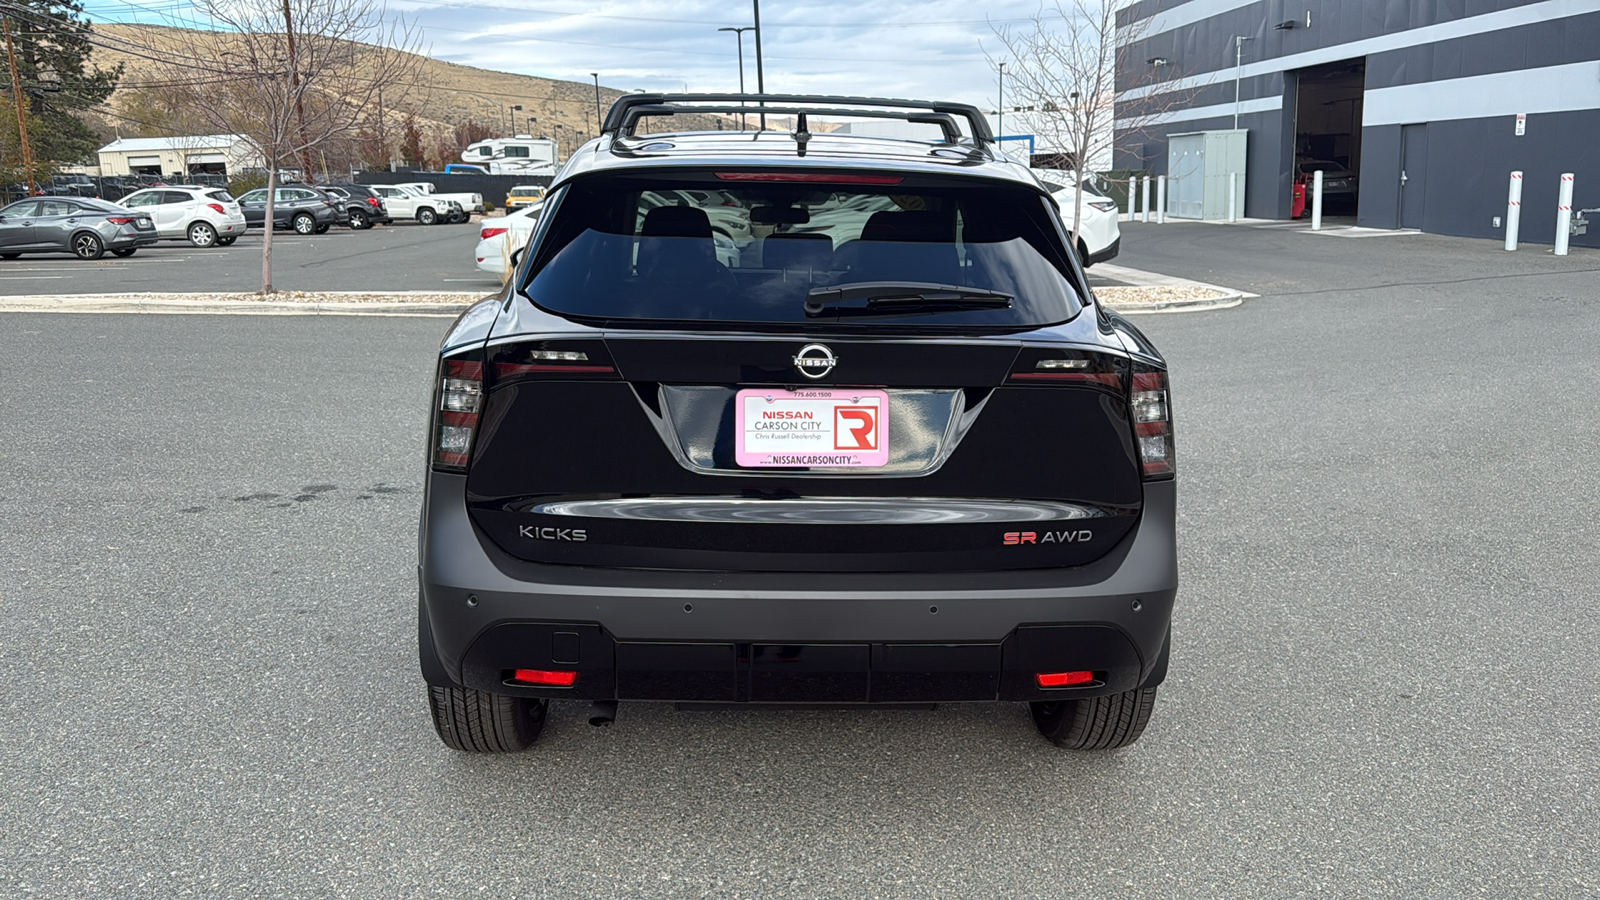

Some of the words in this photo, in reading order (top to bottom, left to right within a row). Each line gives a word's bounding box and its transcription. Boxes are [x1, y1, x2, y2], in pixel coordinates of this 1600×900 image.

[794, 359, 836, 367] NISSAN
[762, 411, 813, 419] NISSAN
[754, 421, 798, 430] CARSON
[800, 421, 822, 430] CITY
[839, 410, 874, 449] R
[791, 433, 822, 441] Dealership
[519, 525, 587, 542] KICKS
[1003, 531, 1037, 545] SR
[1040, 530, 1093, 544] AWD
